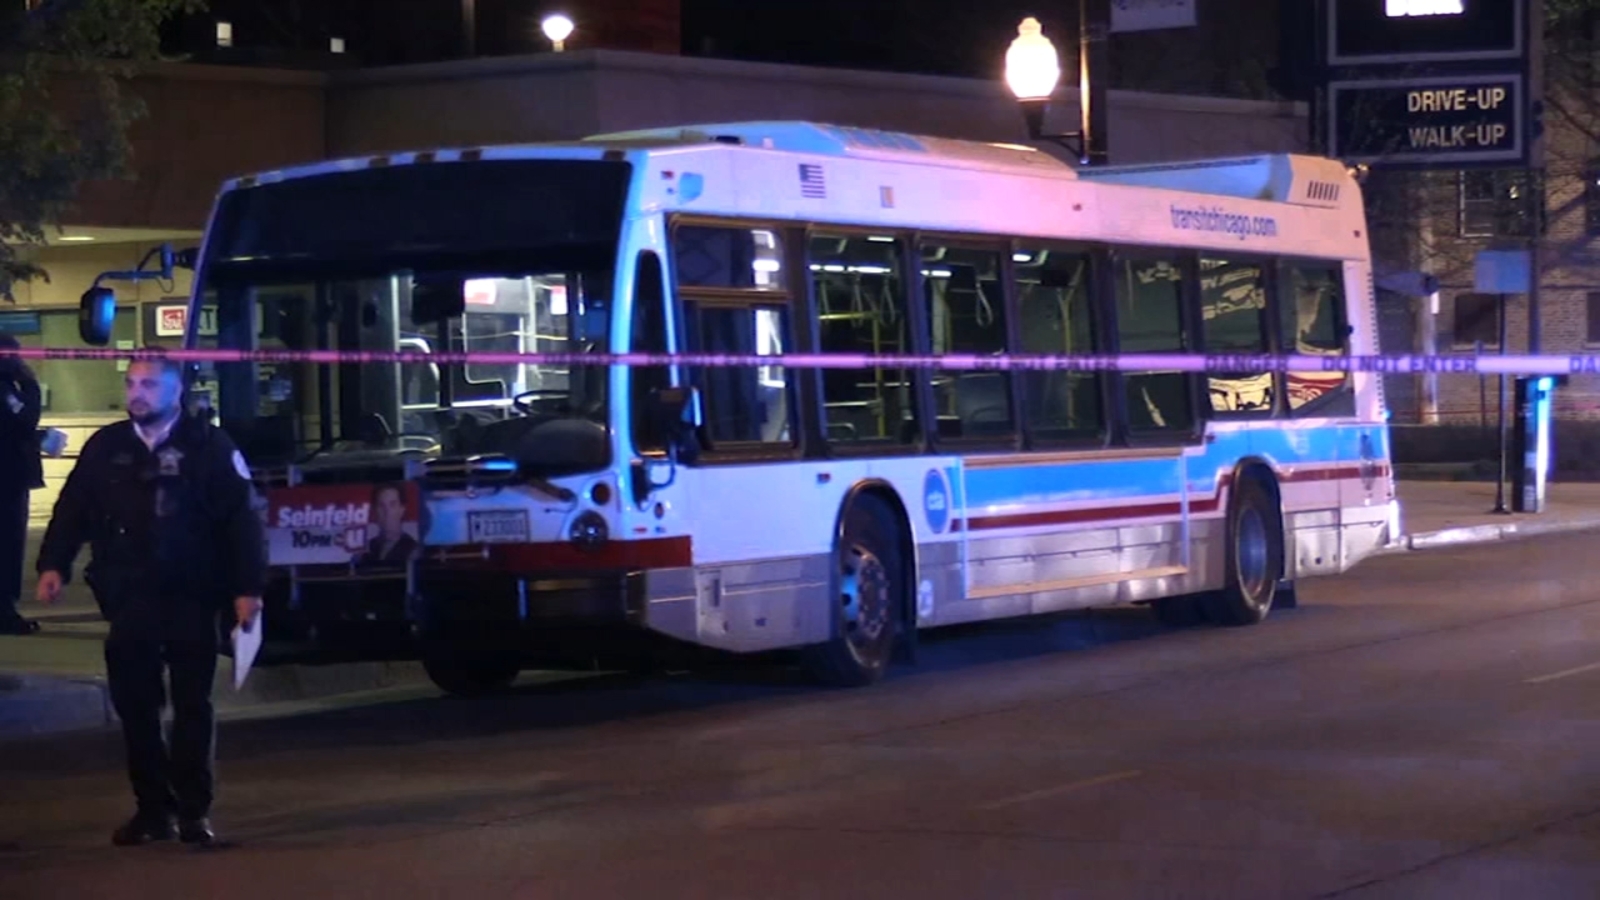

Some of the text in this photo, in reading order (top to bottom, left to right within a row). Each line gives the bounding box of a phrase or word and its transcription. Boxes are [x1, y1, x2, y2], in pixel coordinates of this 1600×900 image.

[1407, 88, 1505, 112] DRIVE-UP
[1409, 124, 1505, 148] WALK-UP
[1170, 204, 1277, 240] transitchicago.com
[1205, 355, 1288, 371] DANGER
[1322, 356, 1348, 371] DO
[1358, 356, 1405, 372] NOT
[1410, 356, 1476, 372] ENTER
[278, 502, 370, 529] Seinfeld
[292, 531, 332, 549] 10PM
